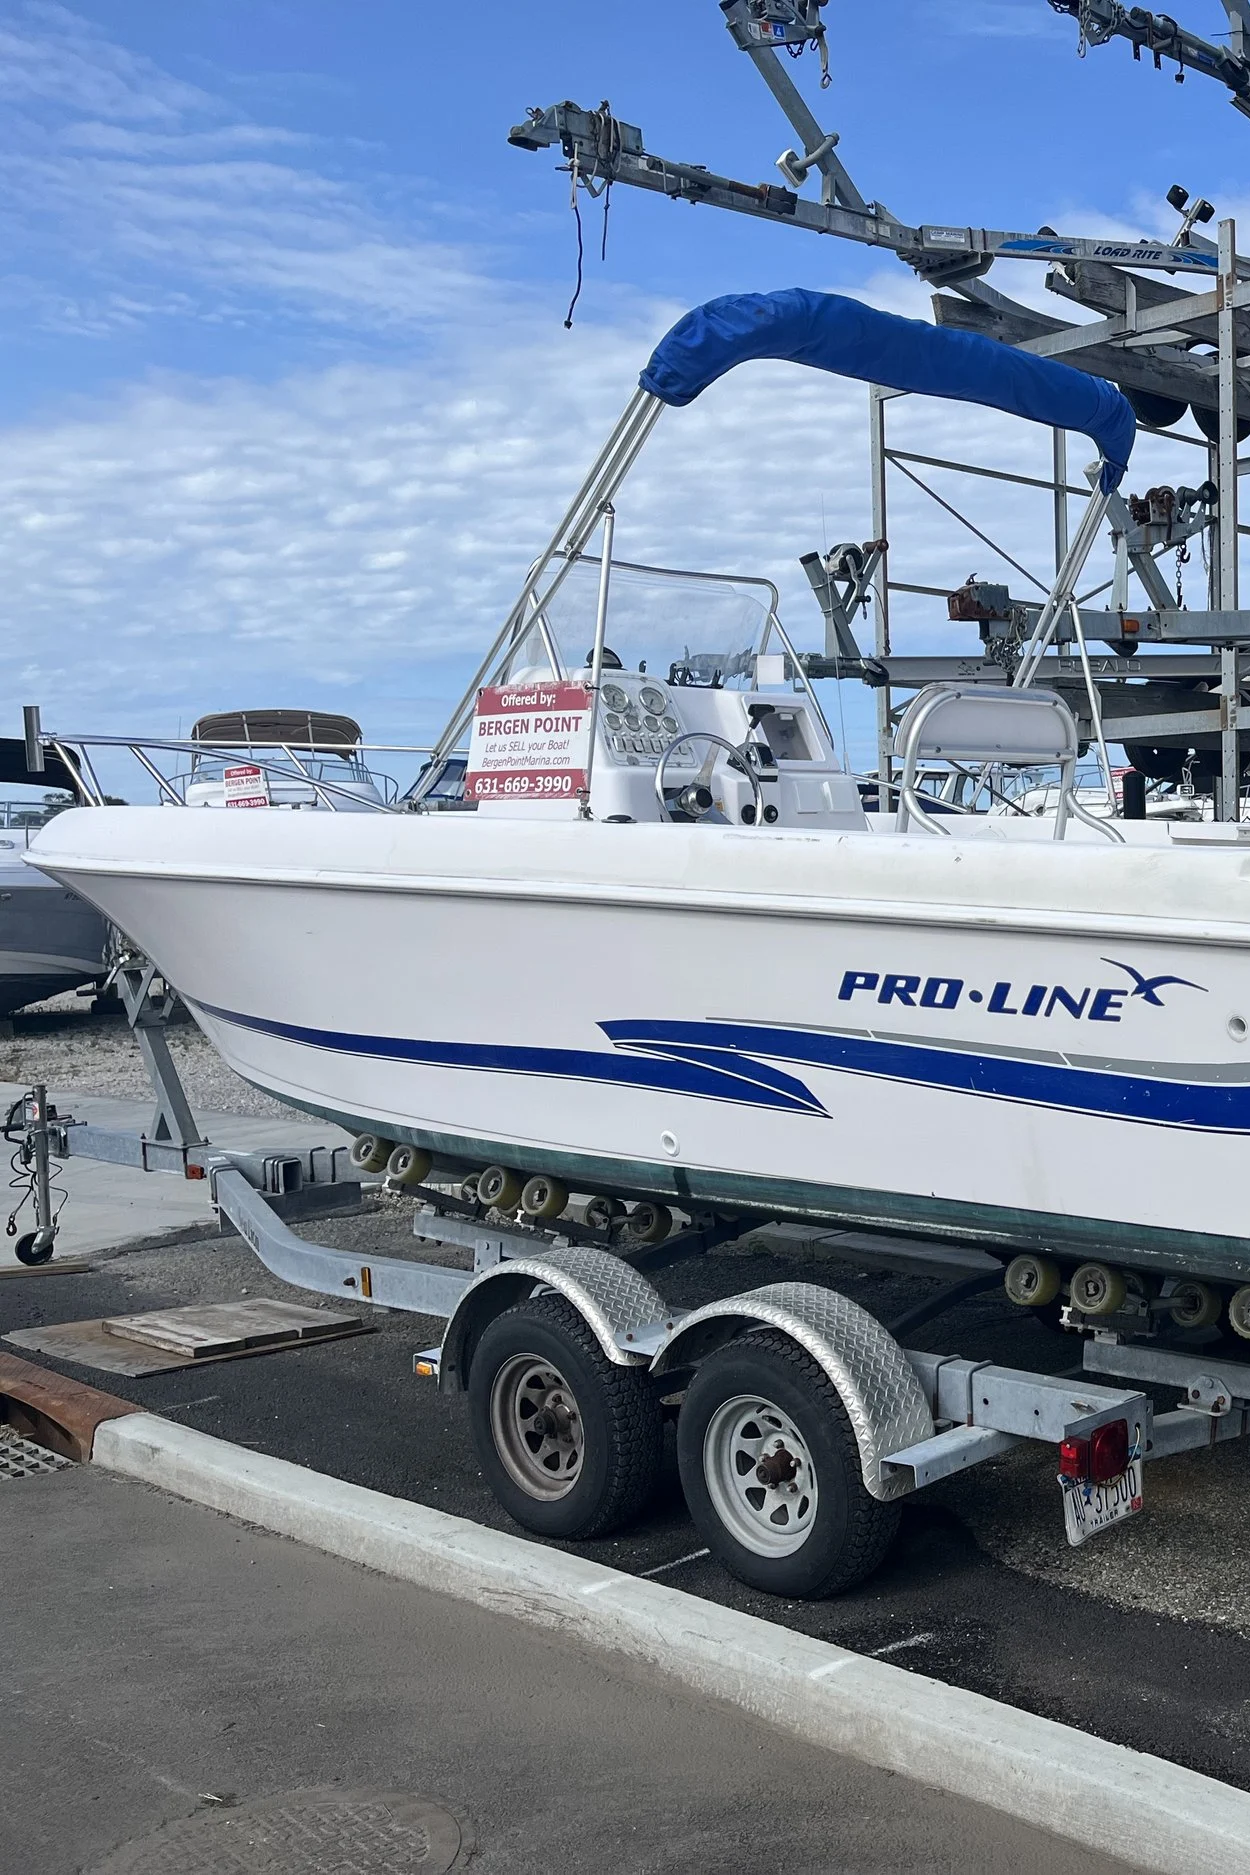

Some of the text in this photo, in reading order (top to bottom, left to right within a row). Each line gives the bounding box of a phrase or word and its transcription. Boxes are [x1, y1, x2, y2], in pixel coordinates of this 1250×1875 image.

[1093, 245, 1163, 260] LOAD RITE
[501, 692, 556, 707] Offered by:
[478, 716, 582, 737] BERGEN POINT
[485, 740, 570, 753] Let us SELL your Boat!
[482, 756, 570, 769] BergenPointMarina.com
[475, 776, 572, 793] 631-669-3990
